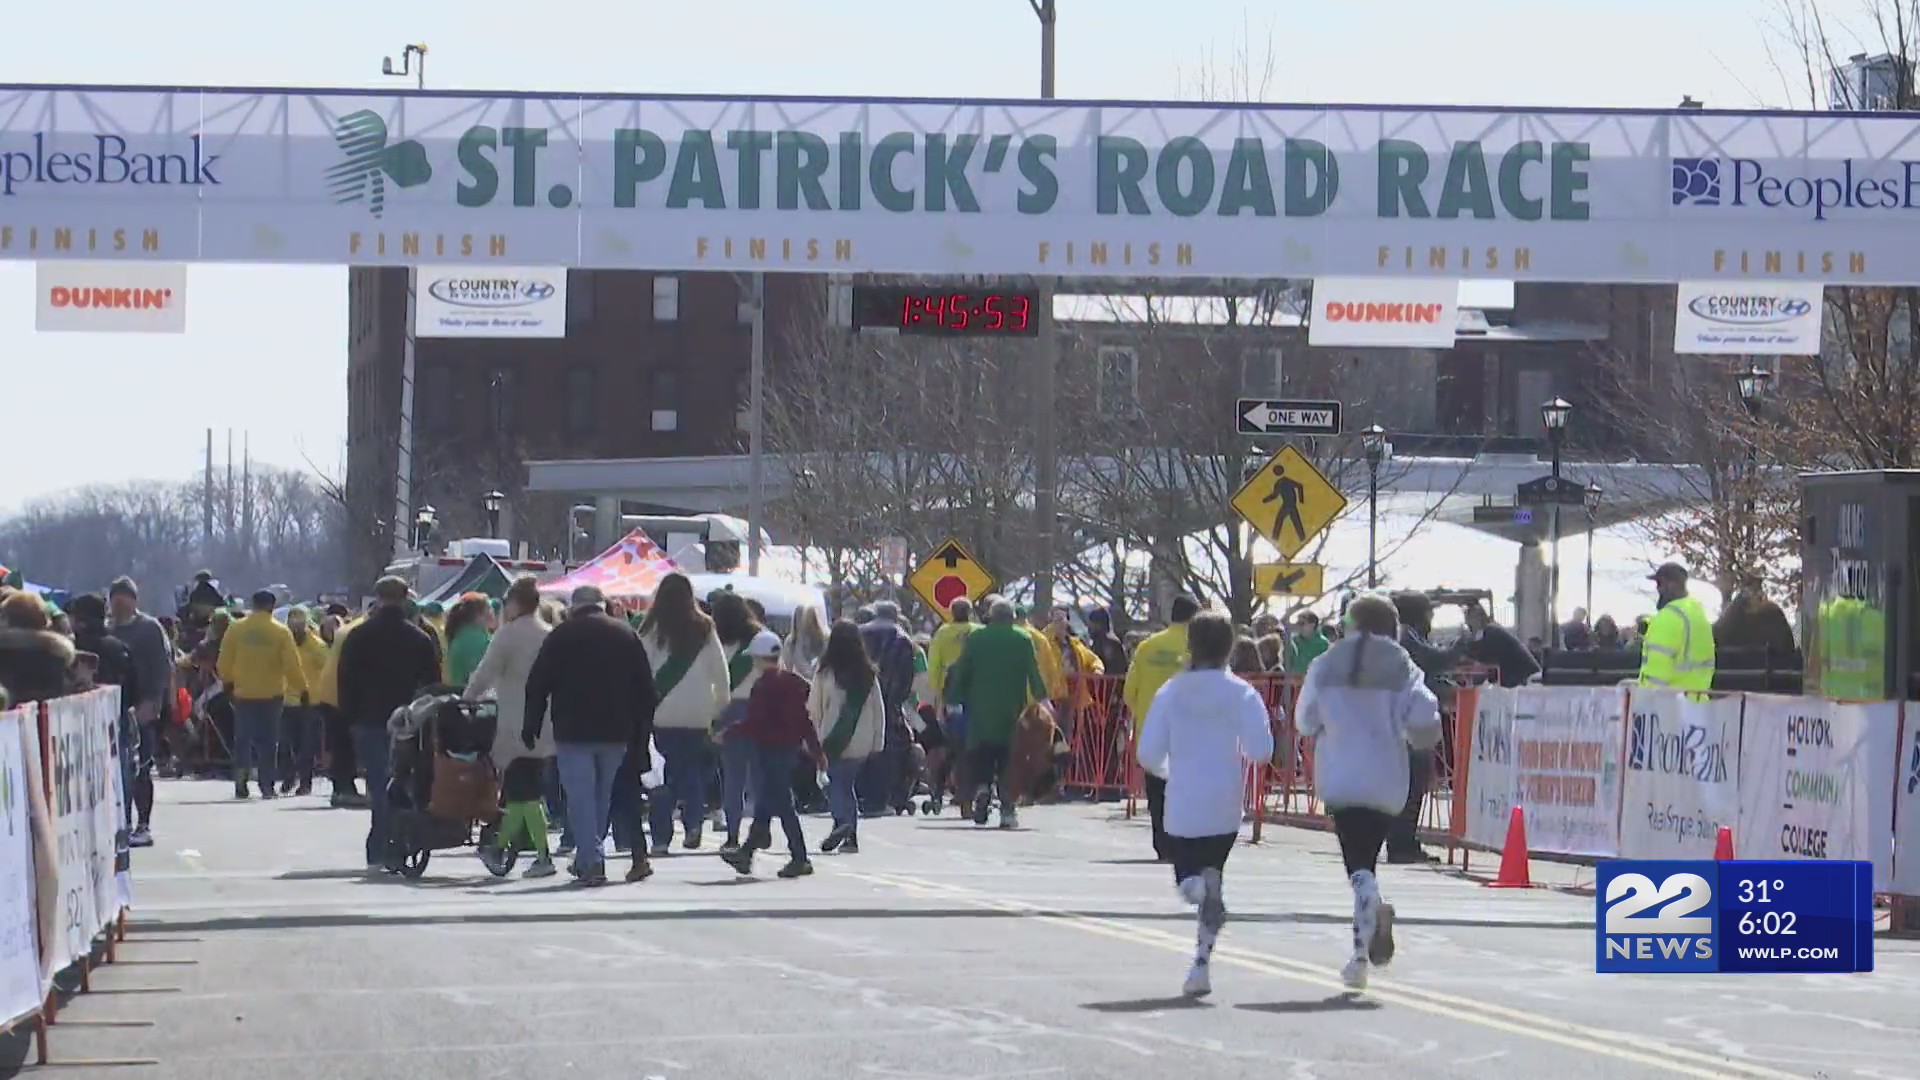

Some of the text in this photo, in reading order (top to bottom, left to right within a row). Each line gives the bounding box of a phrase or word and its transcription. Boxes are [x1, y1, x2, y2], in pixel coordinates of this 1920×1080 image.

[0, 132, 221, 196] plesBank
[456, 126, 1591, 221] ST. PATRICK'S ROAD RACE
[0, 226, 162, 252] FINISH
[349, 232, 508, 257] FINISH
[696, 237, 852, 262] FINISH
[1038, 241, 1194, 266] FINISH
[1377, 246, 1531, 270] FINISH
[1713, 249, 1866, 273] FINISH
[50, 285, 172, 309] DUNKIN'
[448, 279, 519, 291] COUNTRY
[1326, 301, 1443, 324] DUNKIN'
[1708, 296, 1778, 308] COUNTRY
[1267, 409, 1330, 426] ONE WAY
[1788, 715, 1833, 748] HOLYOK
[1781, 823, 1828, 858] COLLEGE
